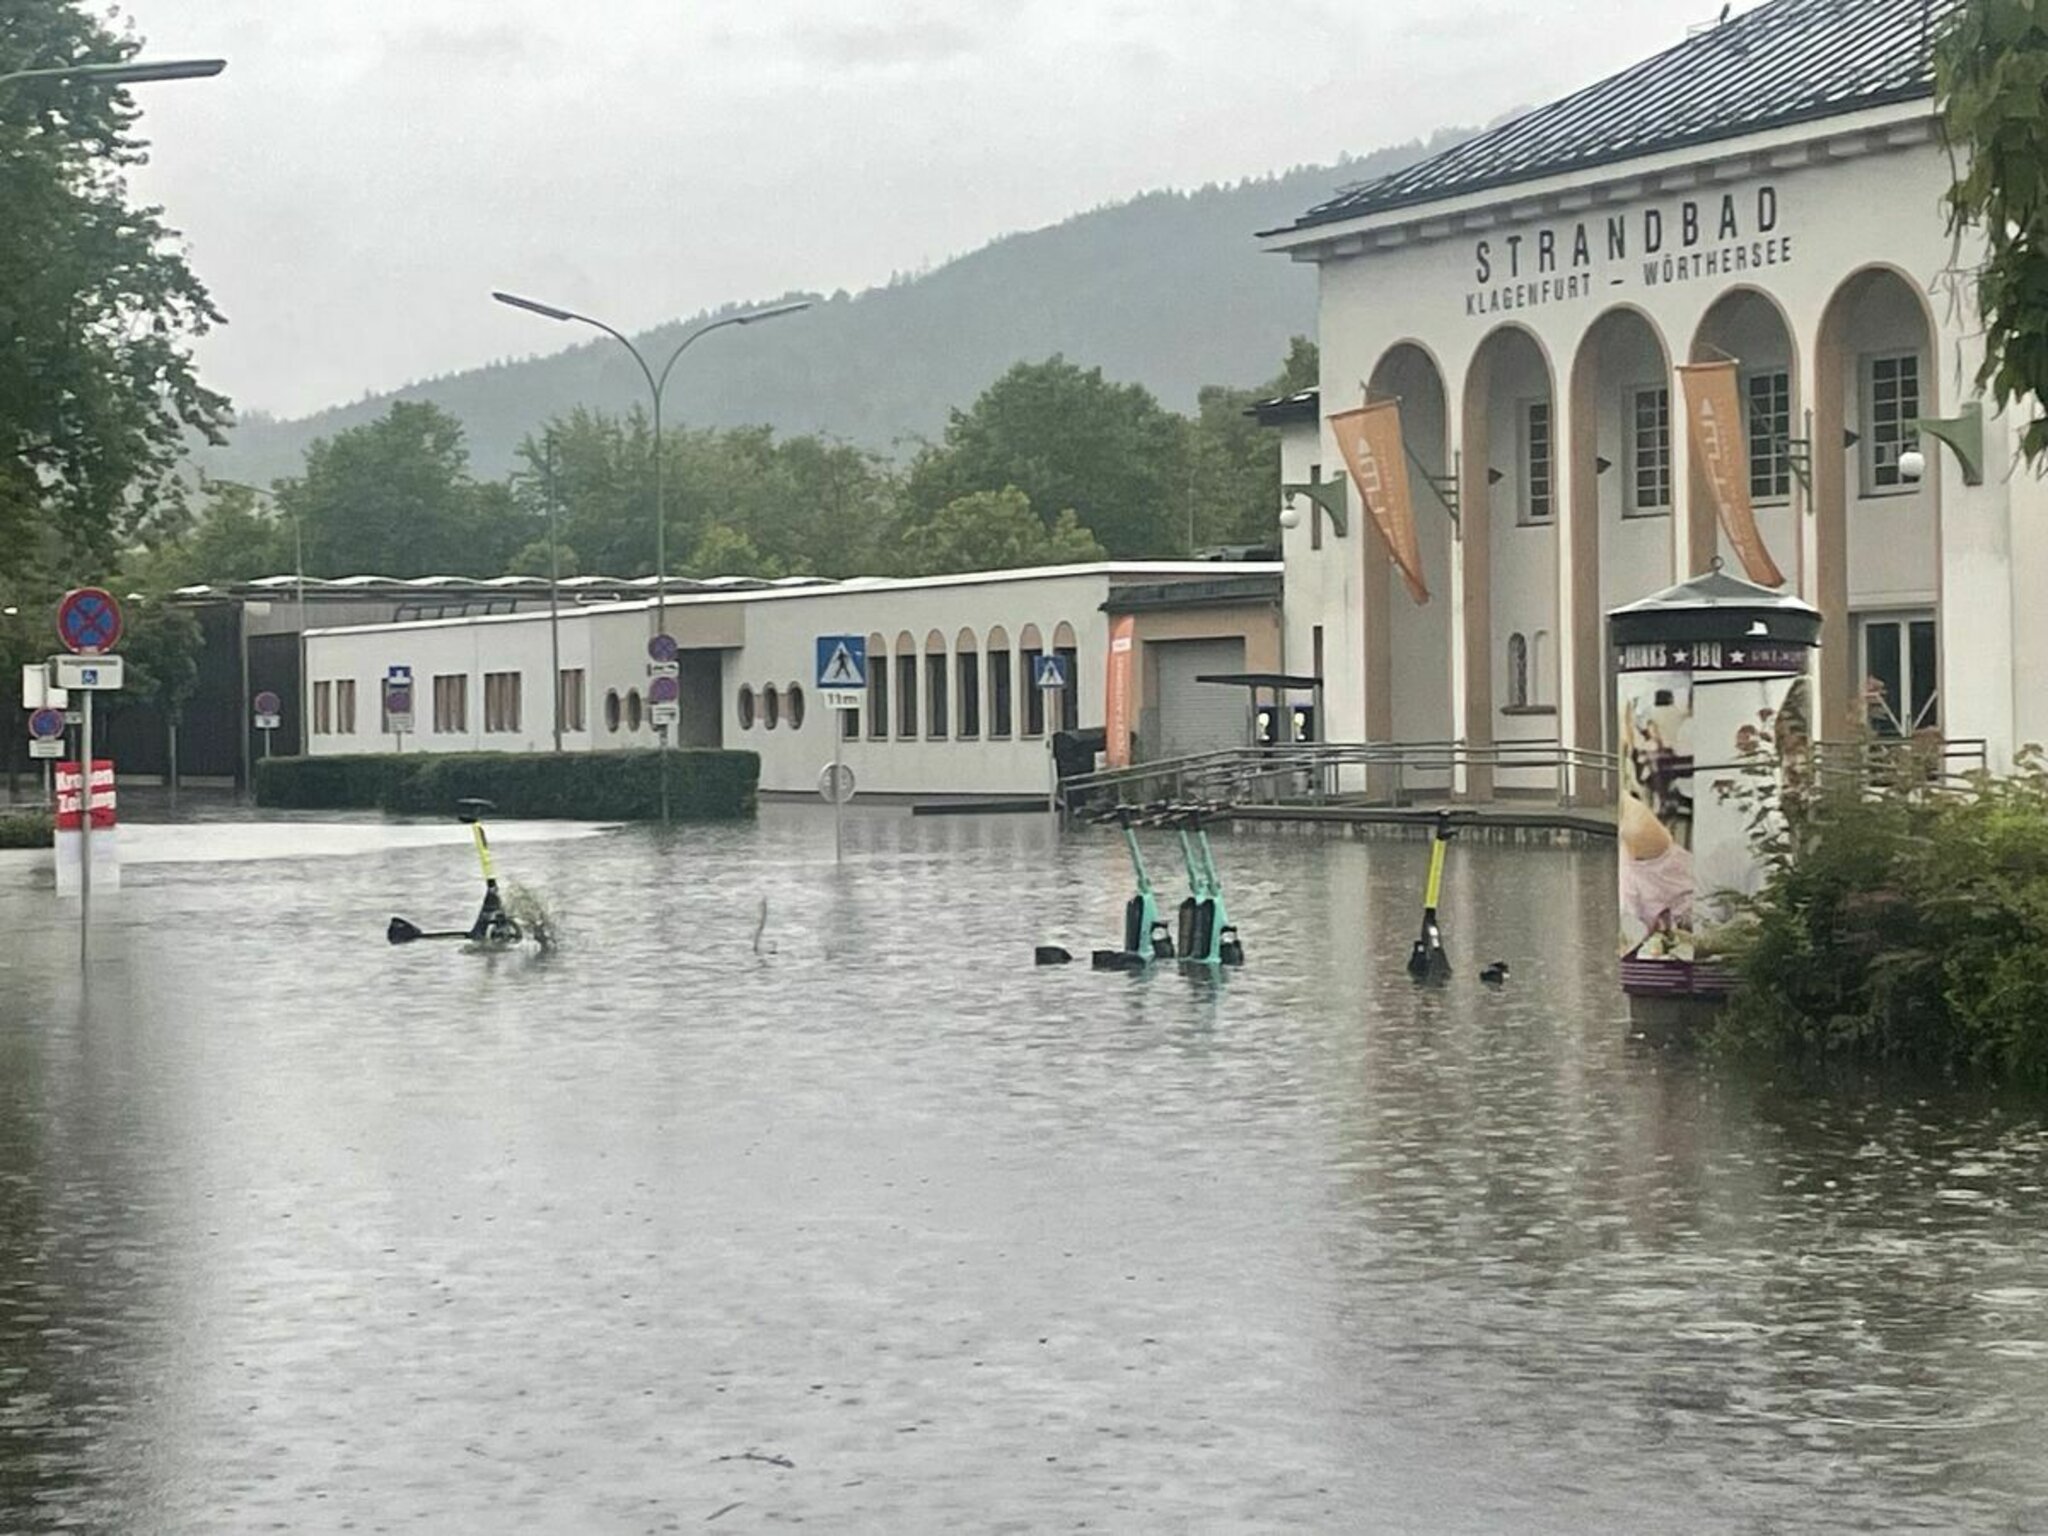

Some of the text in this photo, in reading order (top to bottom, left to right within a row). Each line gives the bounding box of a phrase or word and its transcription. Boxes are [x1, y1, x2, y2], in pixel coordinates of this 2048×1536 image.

[1476, 186, 1777, 284] STRANDBAD
[1465, 273, 1592, 316] KLAGENFURT
[1643, 236, 1793, 287] WÖRTHERSEE
[827, 692, 858, 705] 11m
